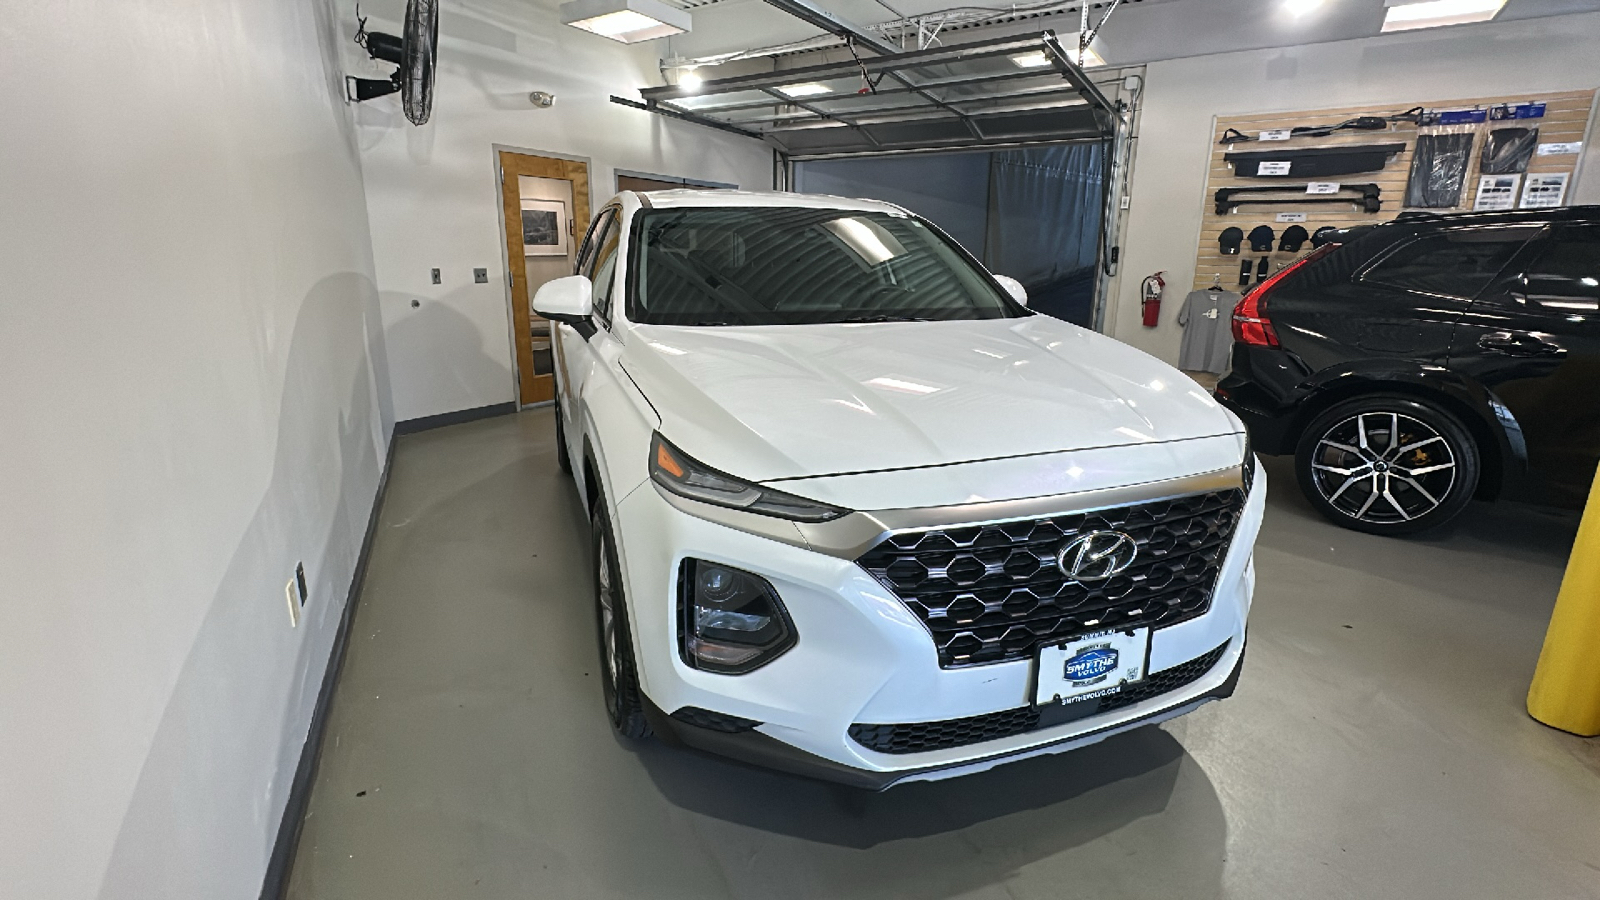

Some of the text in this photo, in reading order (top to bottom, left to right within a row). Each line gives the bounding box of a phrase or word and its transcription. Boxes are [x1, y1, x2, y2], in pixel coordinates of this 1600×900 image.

[1066, 658, 1114, 673] SMYTHE
[1077, 666, 1106, 677] VOLVO
[1062, 687, 1121, 705] SMYTHEVOLVO.COM
